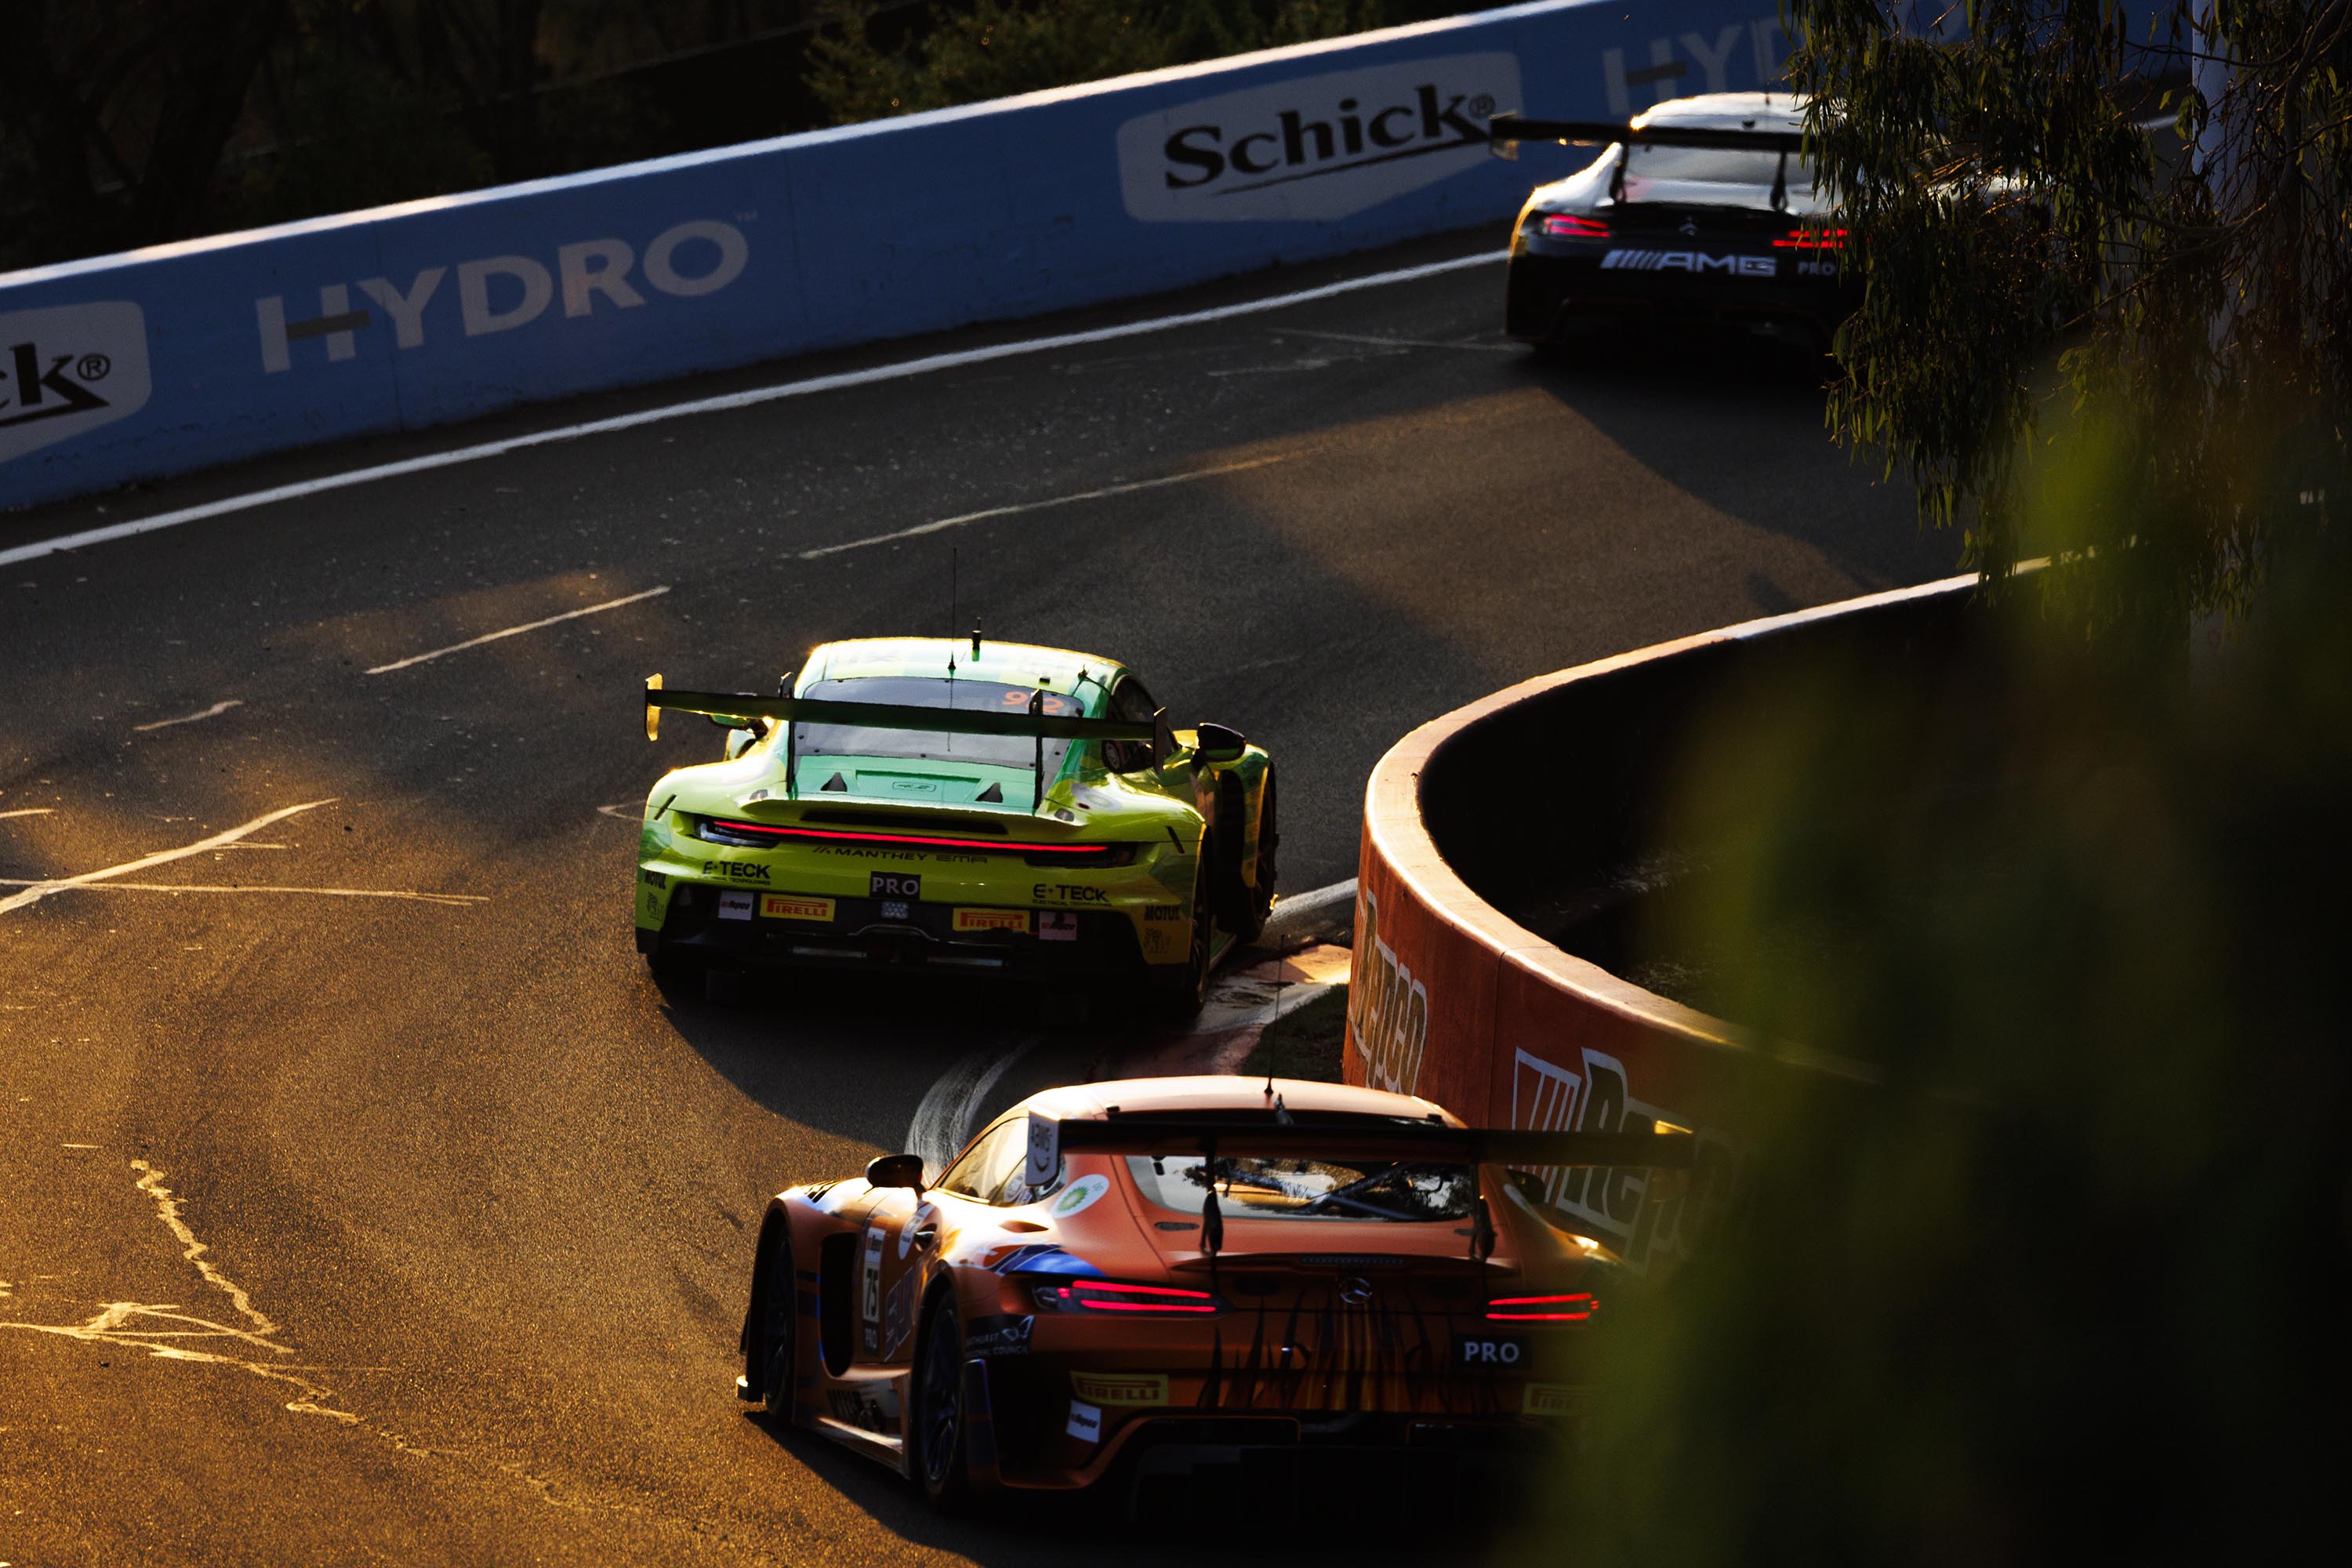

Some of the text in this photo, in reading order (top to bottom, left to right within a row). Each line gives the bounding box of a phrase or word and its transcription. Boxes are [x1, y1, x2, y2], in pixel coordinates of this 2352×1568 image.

[1165, 85, 1490, 189] Schick
[1653, 250, 1777, 278] AMG
[1798, 260, 1836, 276] PRO
[256, 220, 750, 373] HYDRO
[1002, 691, 1064, 713] 92
[834, 847, 928, 862] MANTHEY
[871, 877, 920, 896] PRO
[767, 899, 828, 917] PIRELLI
[960, 912, 1023, 930] PIRELLI
[865, 1266, 879, 1317] 75
[1463, 1341, 1520, 1364] PRO
[1076, 1377, 1160, 1400] PIRELLI
